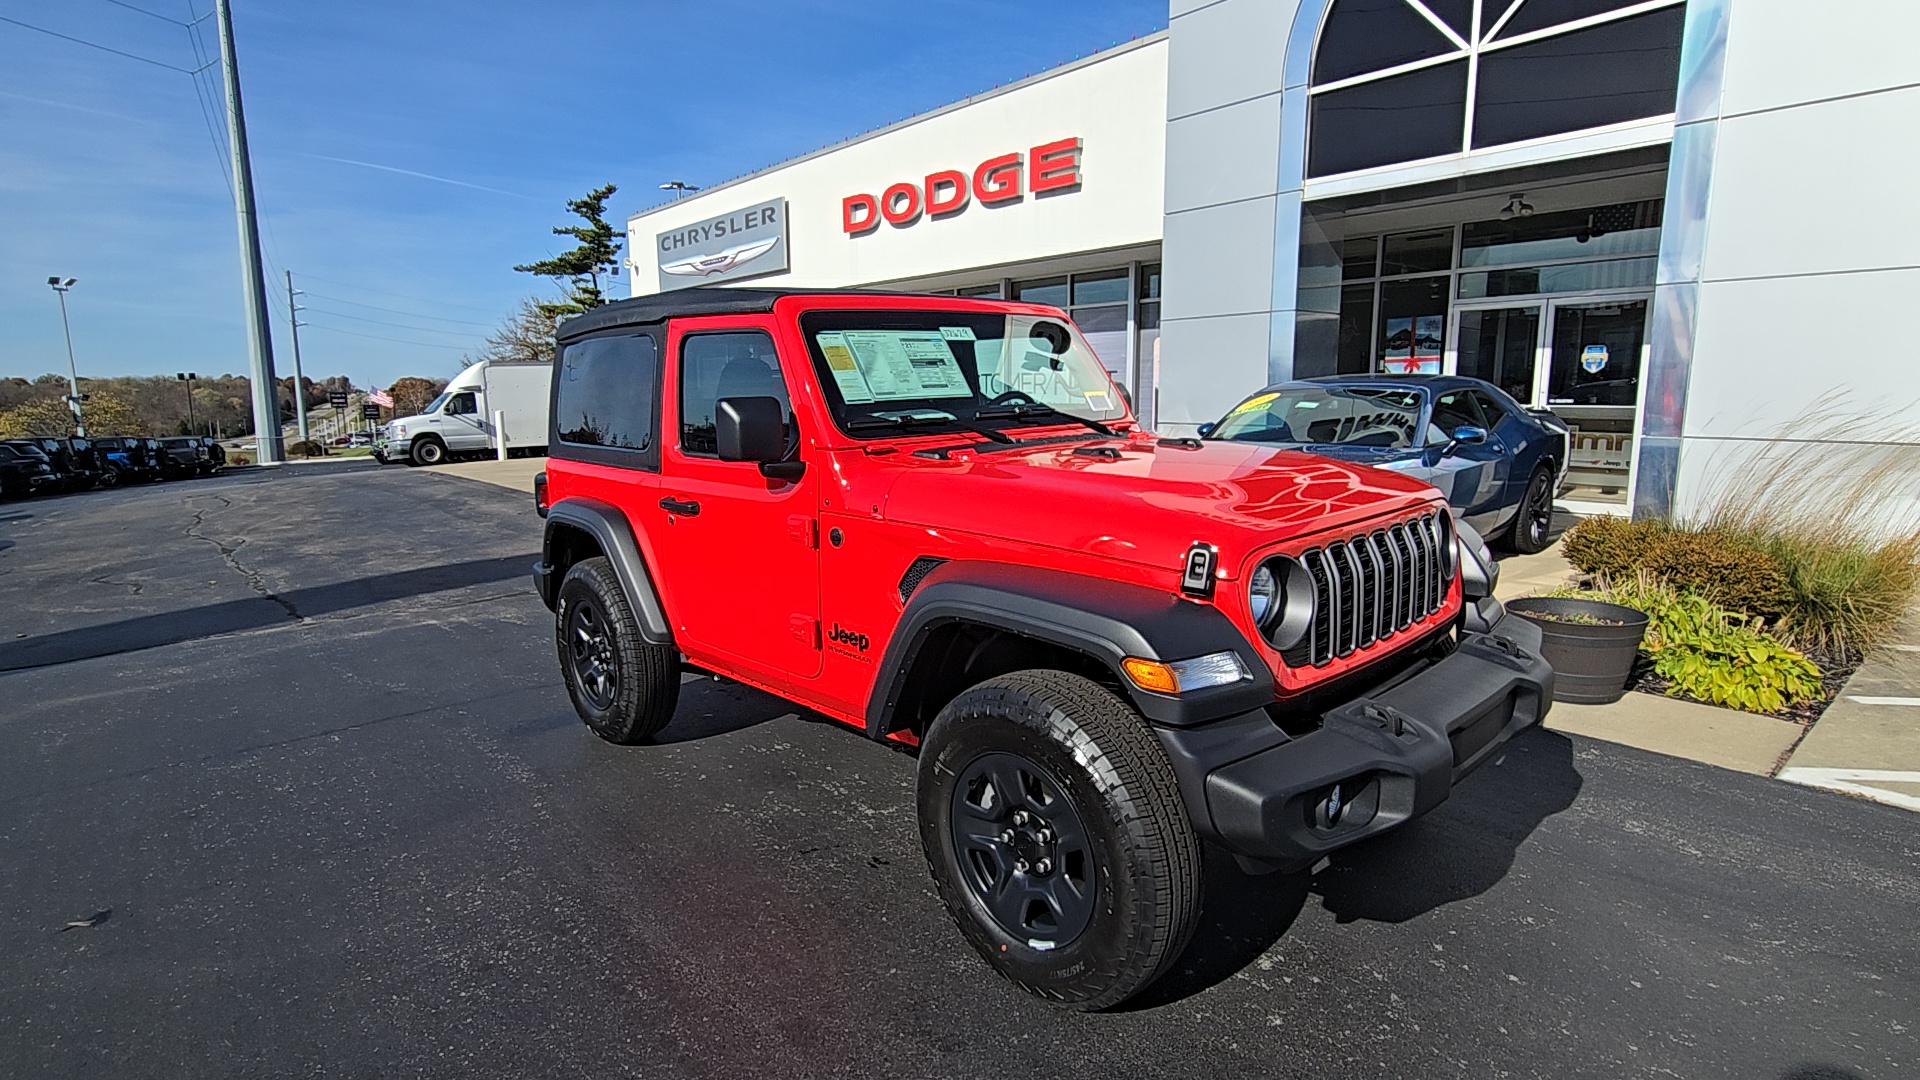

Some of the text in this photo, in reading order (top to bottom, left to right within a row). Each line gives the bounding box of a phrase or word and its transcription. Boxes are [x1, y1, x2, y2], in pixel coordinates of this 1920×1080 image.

[843, 137, 1082, 233] DODGE
[661, 206, 776, 252] CHRYSLER
[828, 622, 870, 652] Jeep
